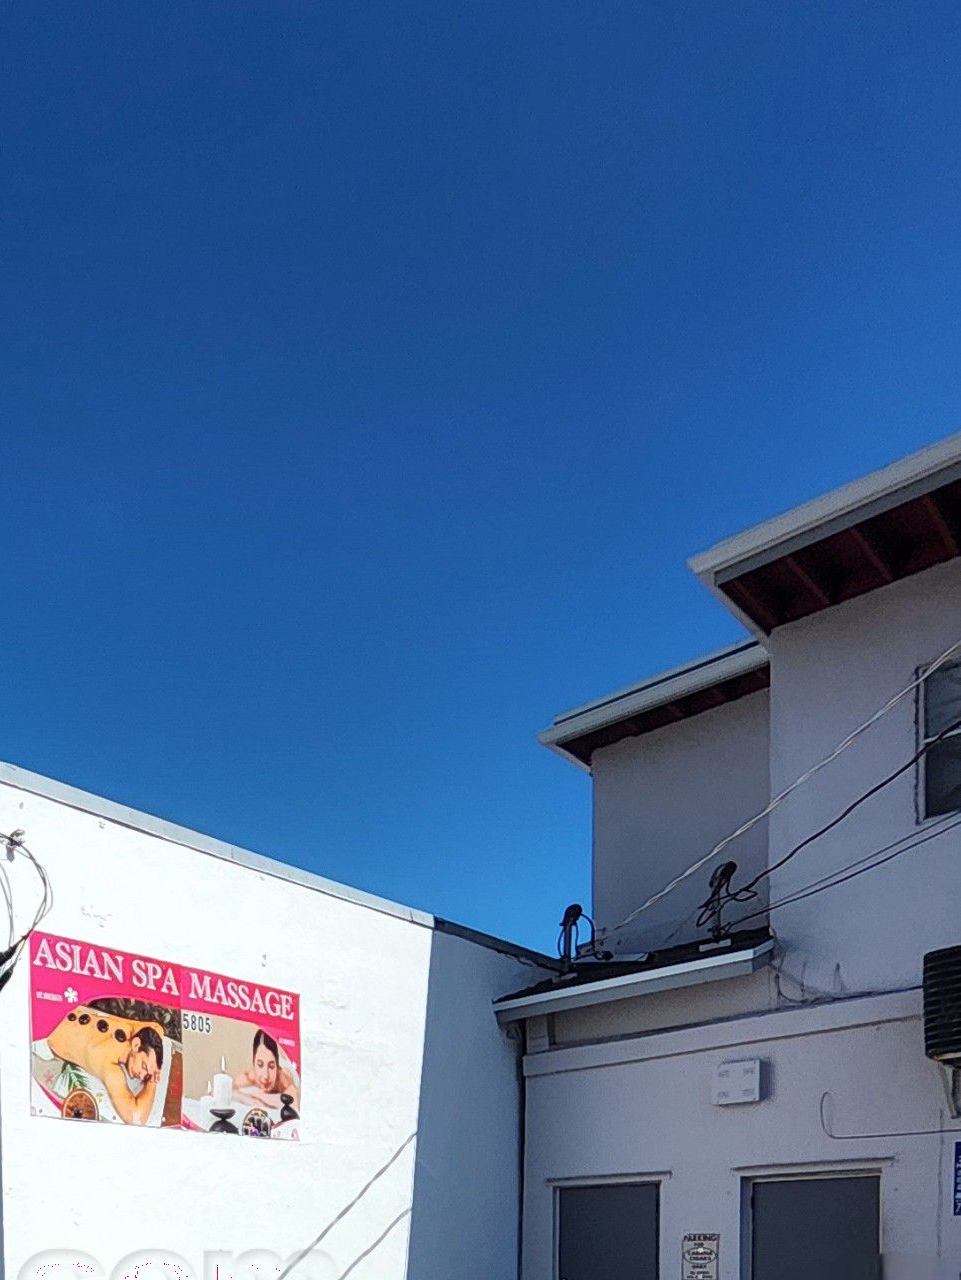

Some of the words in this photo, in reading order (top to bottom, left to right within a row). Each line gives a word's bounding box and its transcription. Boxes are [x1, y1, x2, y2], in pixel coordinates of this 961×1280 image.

[33, 938, 124, 984] ASIAN
[131, 959, 180, 996] SPA
[189, 972, 294, 1021] MASSAGE
[183, 1013, 212, 1034] 5805
[683, 1234, 718, 1242] PARKING
